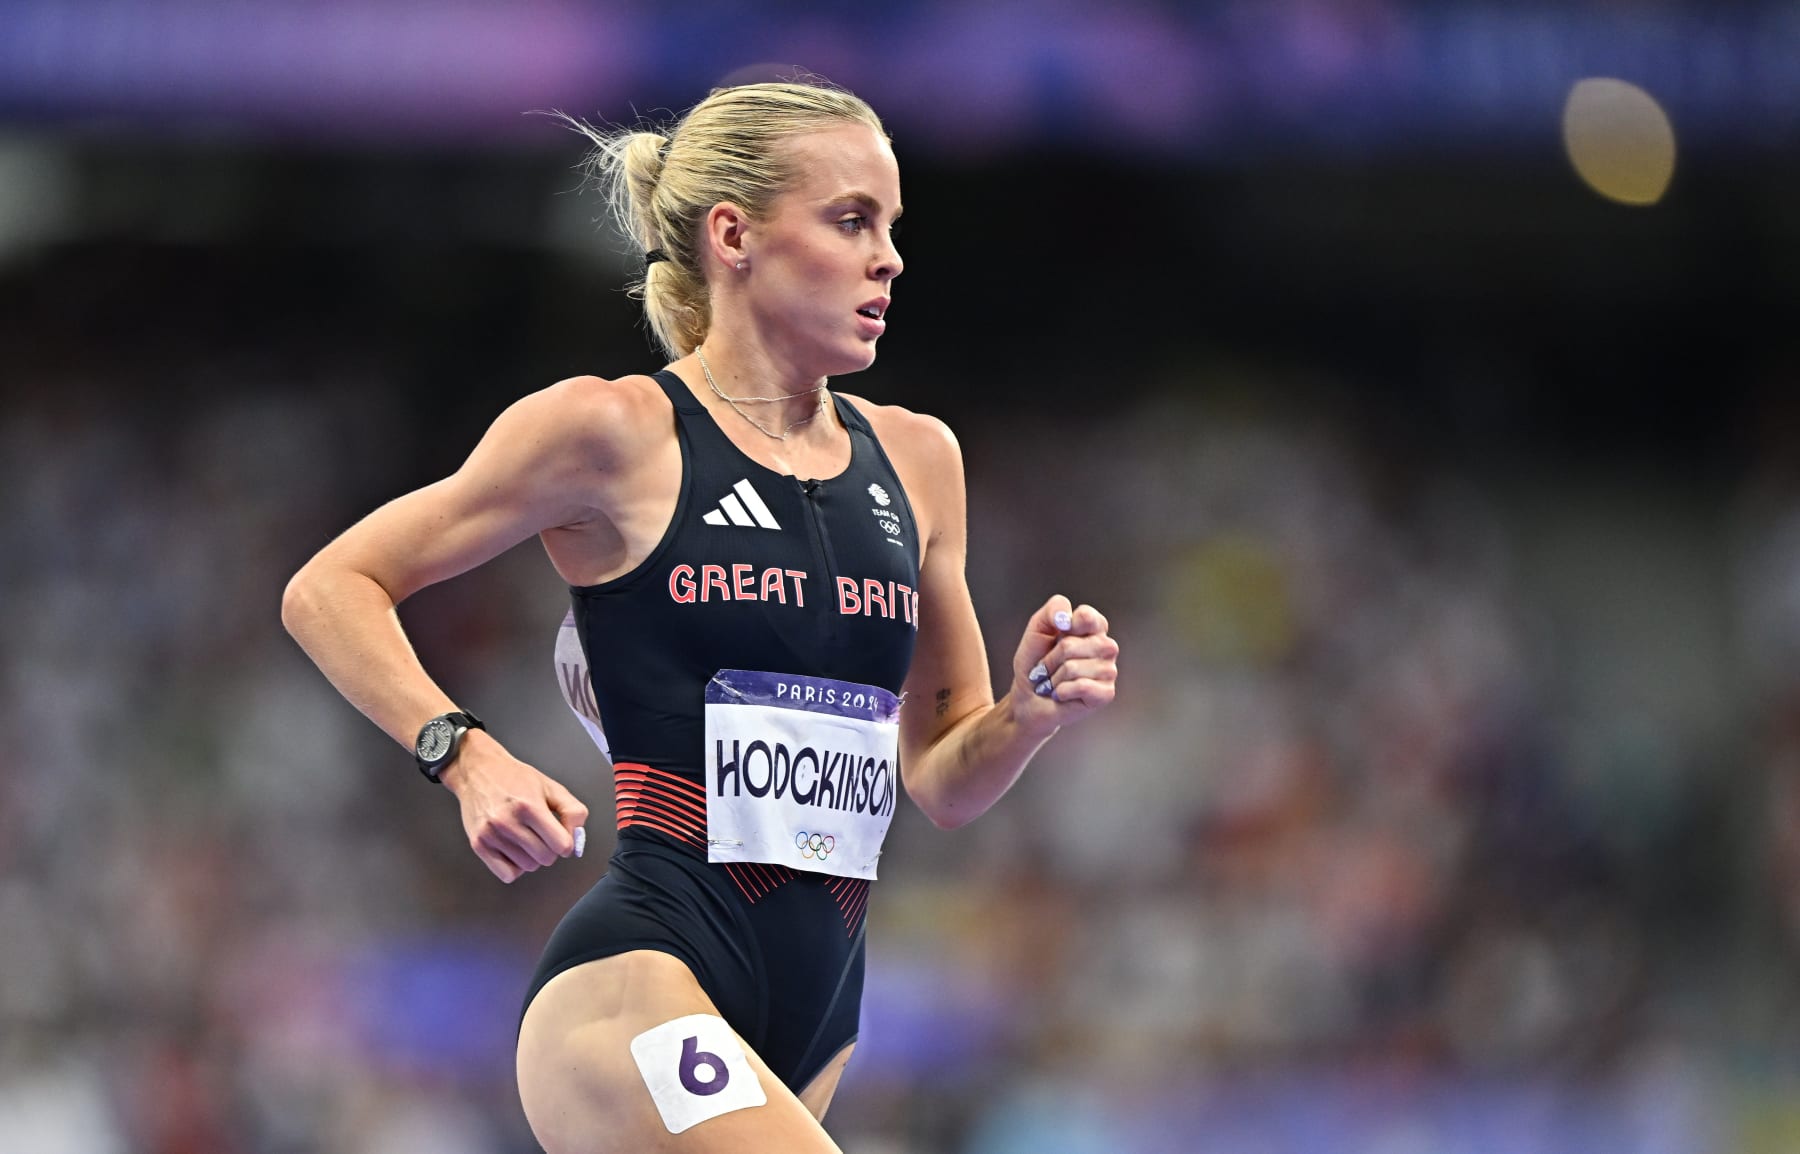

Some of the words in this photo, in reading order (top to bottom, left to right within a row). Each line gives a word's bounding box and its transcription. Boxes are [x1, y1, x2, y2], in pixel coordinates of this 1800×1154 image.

[669, 563, 807, 607] GREAT
[842, 691, 879, 712] 2024
[716, 739, 895, 817] HODGKINSON
[678, 1035, 730, 1097] 6
